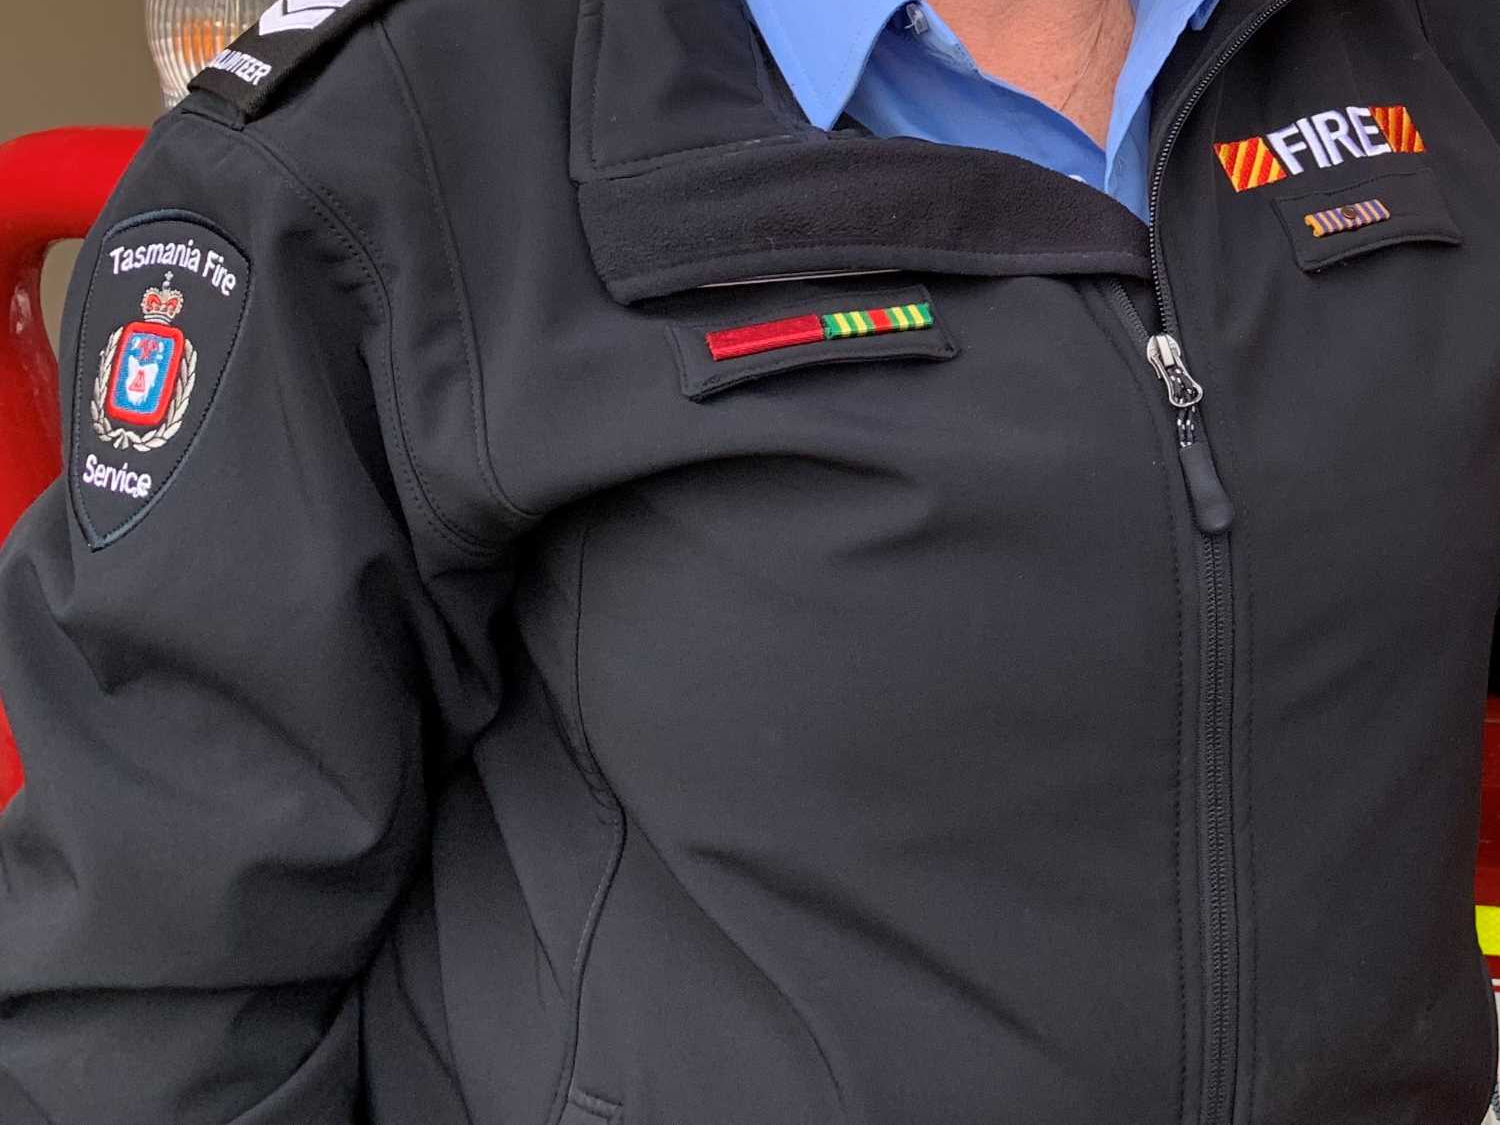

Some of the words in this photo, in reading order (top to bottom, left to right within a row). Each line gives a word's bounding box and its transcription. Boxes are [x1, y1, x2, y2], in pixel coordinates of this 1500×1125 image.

[1266, 106, 1392, 175] FIRE
[109, 239, 202, 275] Tasmania
[202, 250, 237, 296] Fire
[82, 454, 153, 498] Service
